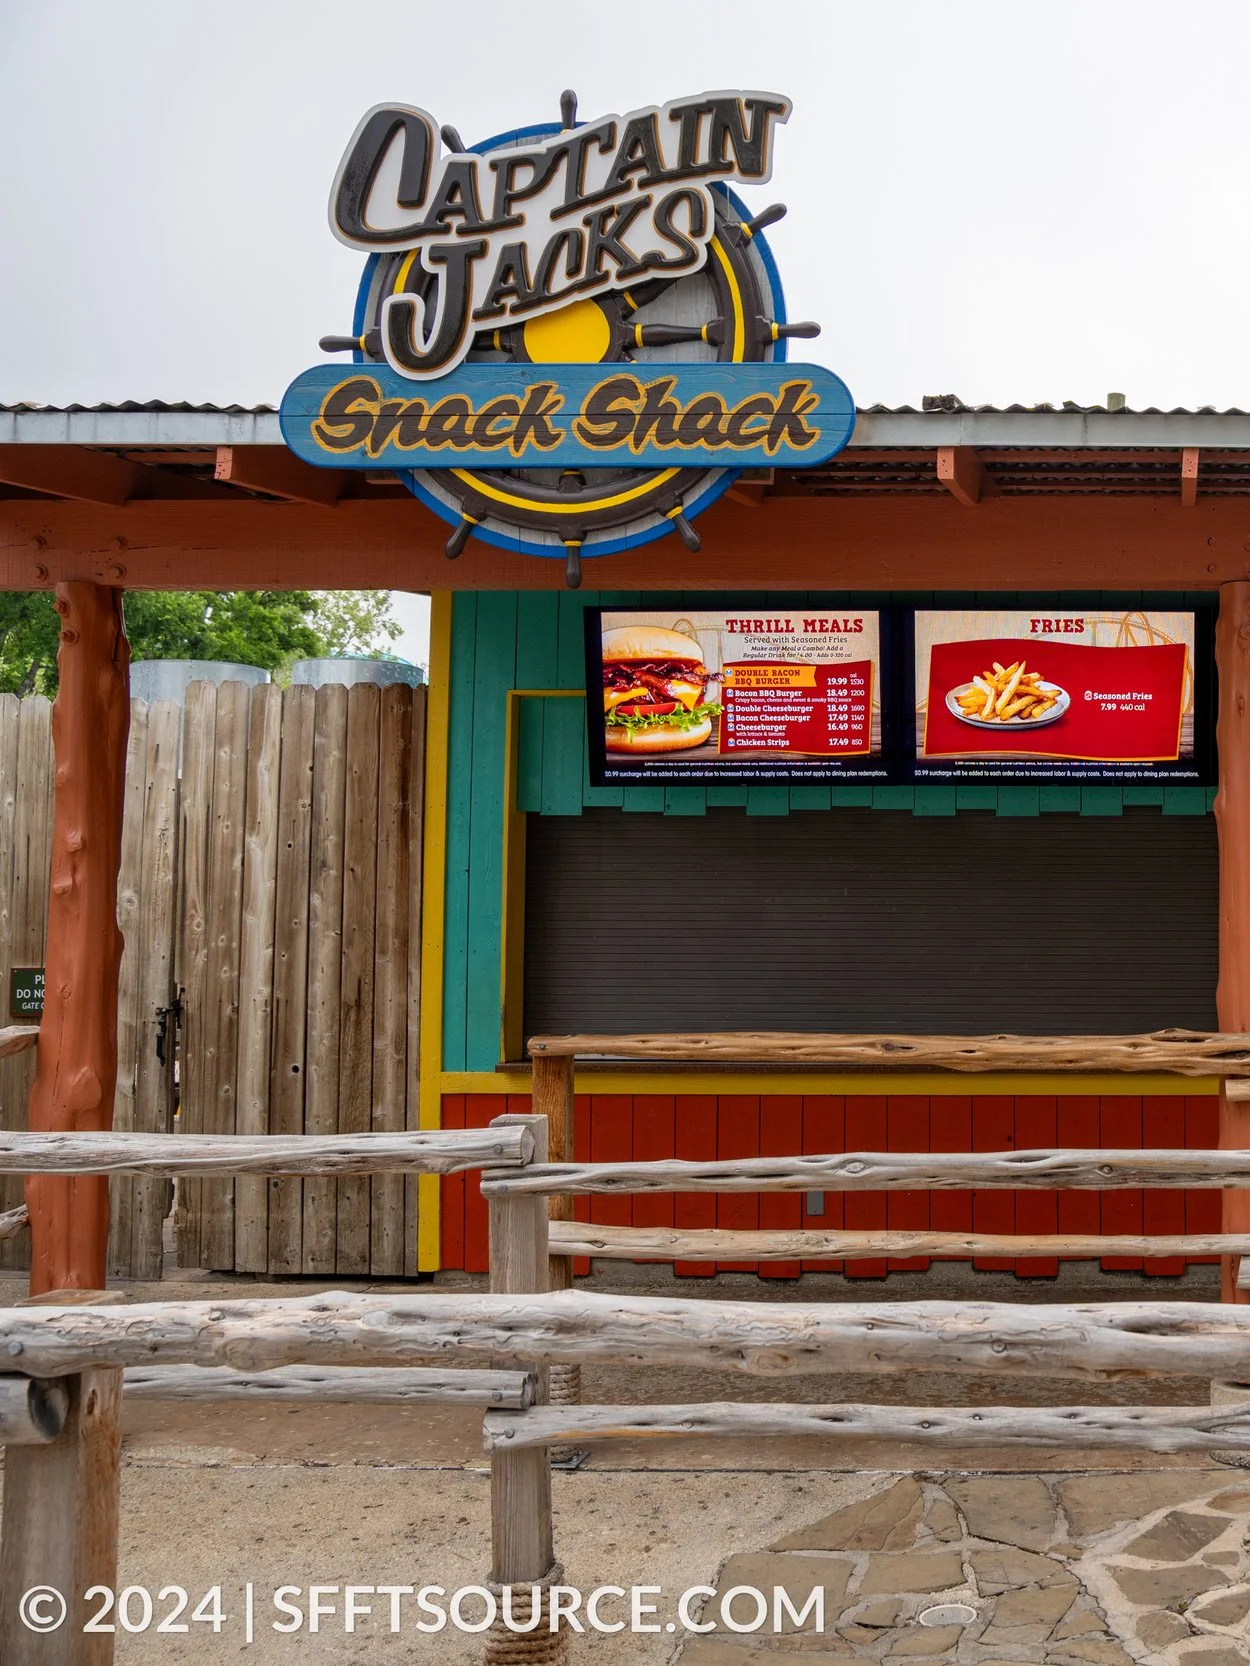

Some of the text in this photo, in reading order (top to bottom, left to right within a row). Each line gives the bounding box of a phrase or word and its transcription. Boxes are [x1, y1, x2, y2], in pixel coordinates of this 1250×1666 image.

[335, 97, 786, 242] CAPTAIN
[311, 373, 822, 457] Snack Shack
[726, 619, 863, 633] THRILL MEALS
[1030, 619, 1084, 633] FRIES
[776, 690, 802, 698] Burger
[762, 705, 813, 713] Cheeseburger
[760, 714, 810, 722] Cheeseburger
[736, 724, 786, 732] Cheeseburger
[16, 989, 30, 998] DO
